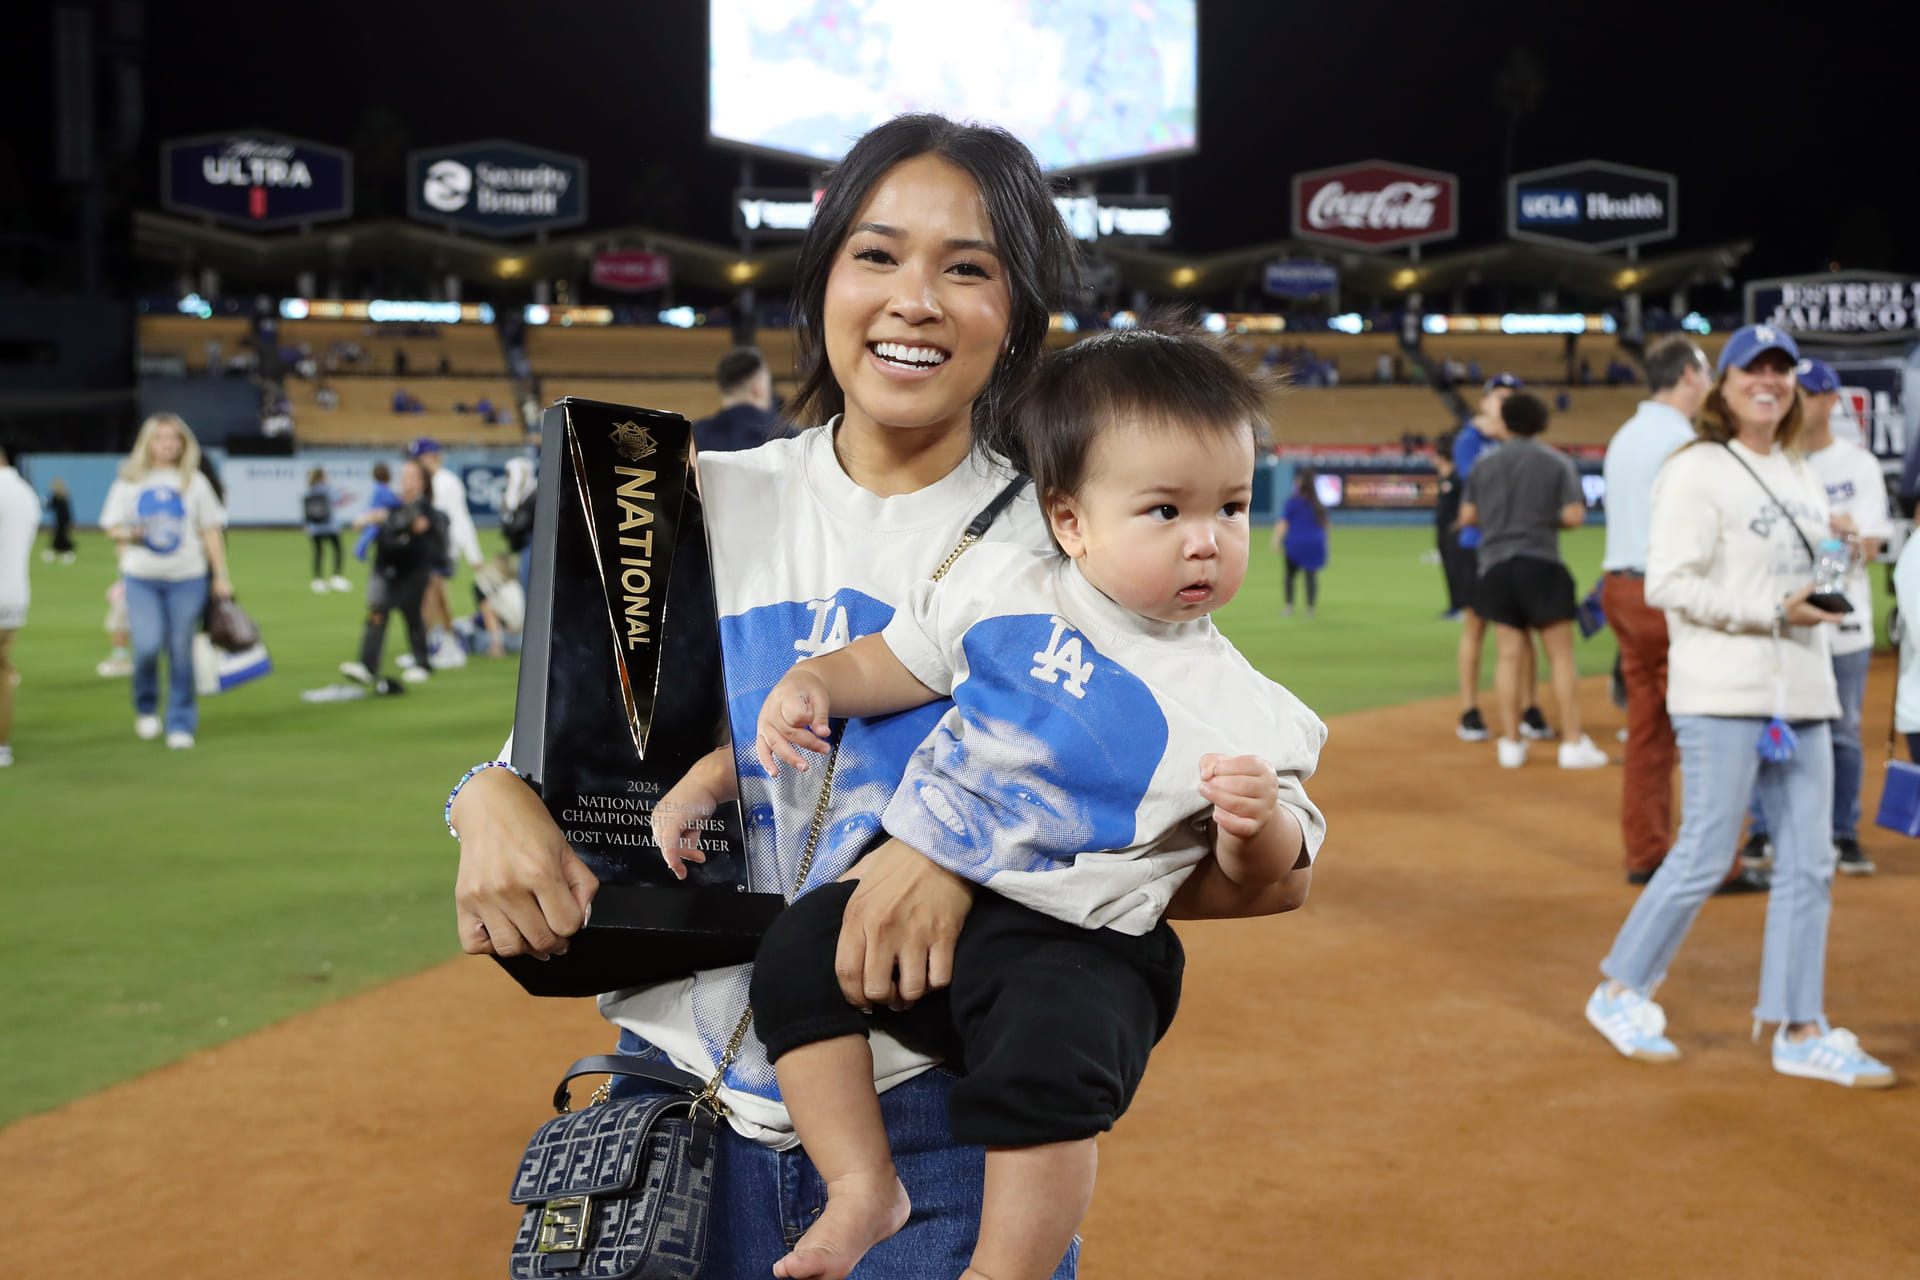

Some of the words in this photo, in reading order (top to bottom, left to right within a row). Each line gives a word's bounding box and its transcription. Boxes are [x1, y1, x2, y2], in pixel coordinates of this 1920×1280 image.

[203, 156, 312, 188] ULTRA
[475, 163, 571, 197] Security
[1521, 194, 1578, 219] UCLA
[1586, 192, 1664, 220] Health
[614, 465, 657, 651] NATIONAL
[1030, 615, 1094, 699] LA
[627, 780, 660, 794] 2024
[578, 795, 653, 812] NATIONAL
[562, 809, 677, 828] CHAMPIONSHIP
[679, 818, 725, 832] SERIES
[562, 829, 602, 844] MOST
[605, 832, 676, 849] VALUABLE
[679, 837, 730, 852] PLAYER
